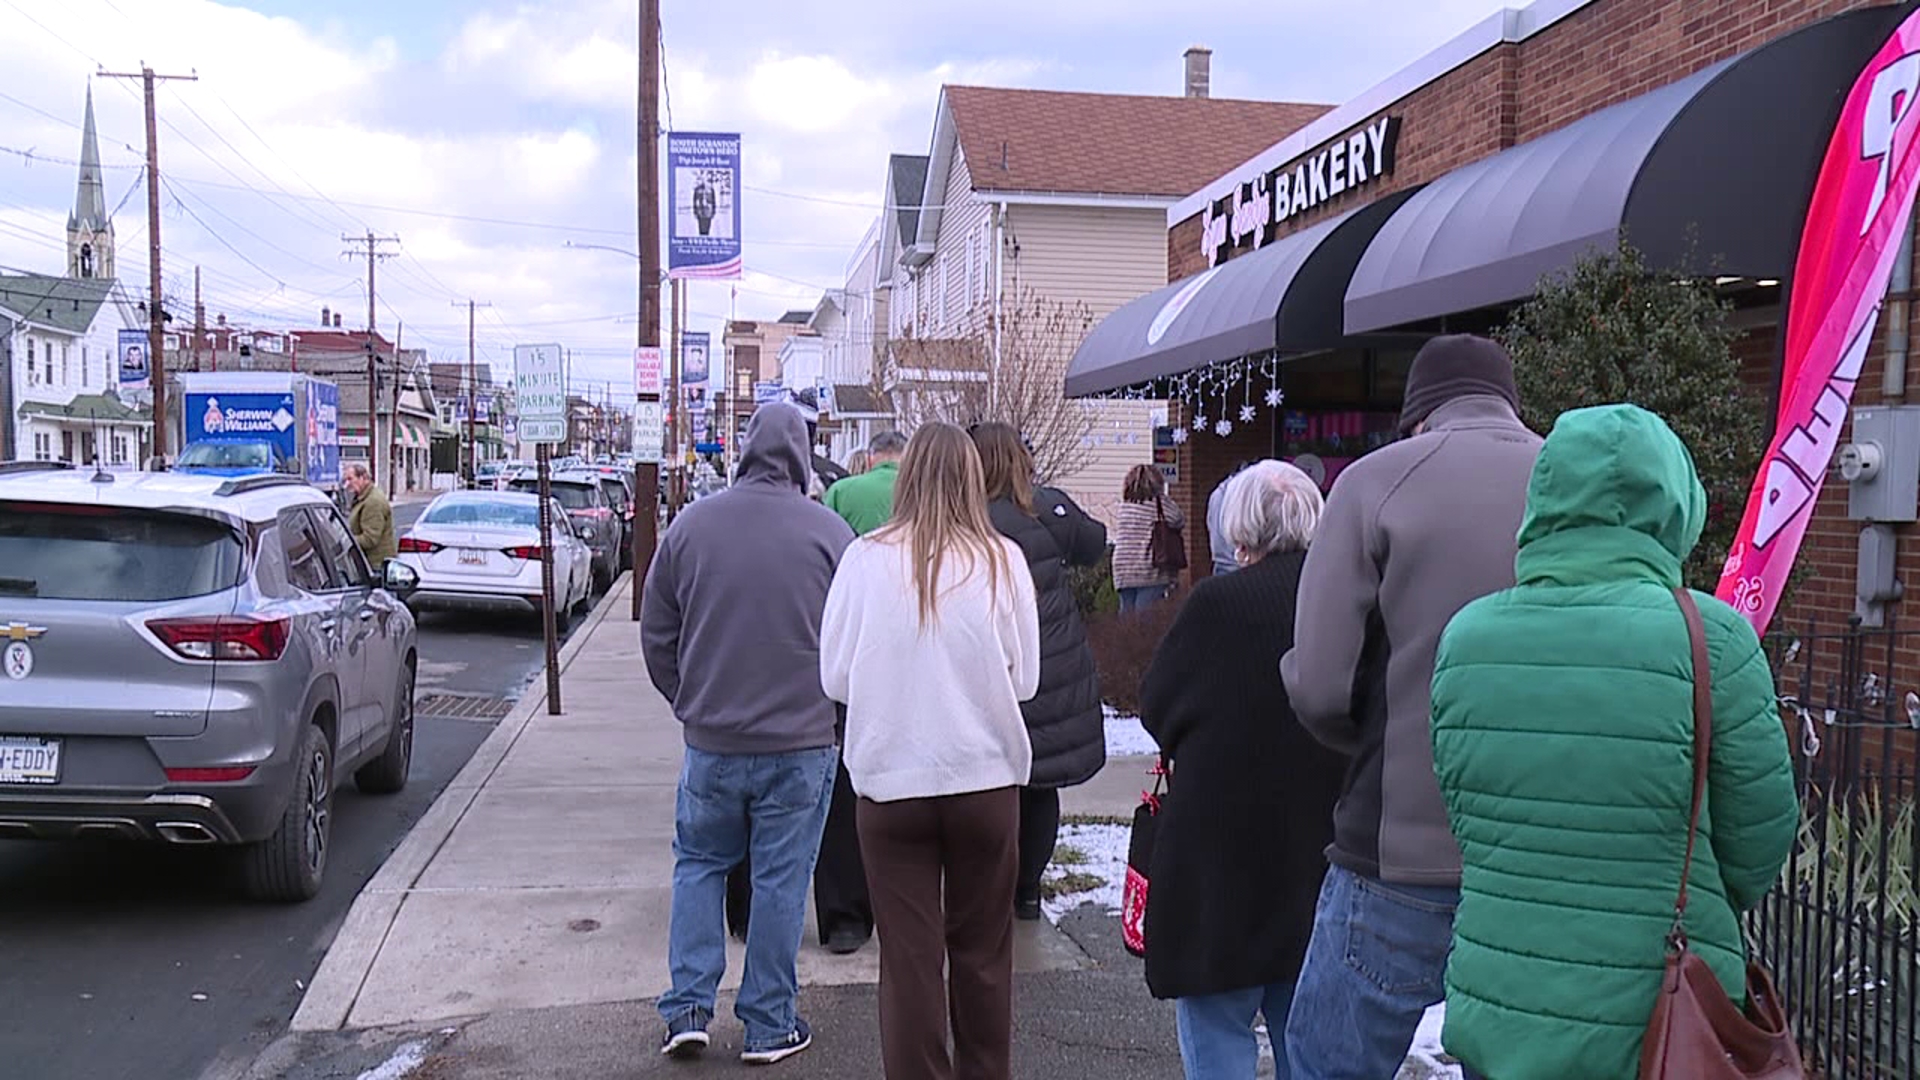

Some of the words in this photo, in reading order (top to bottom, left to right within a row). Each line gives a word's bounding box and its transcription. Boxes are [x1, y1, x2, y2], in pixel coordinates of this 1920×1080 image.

[1274, 116, 1389, 223] BAKERY
[531, 352, 545, 366] 15
[519, 372, 559, 388] MINUTE
[520, 392, 561, 408] PARKING
[225, 409, 273, 420] SHERWIN
